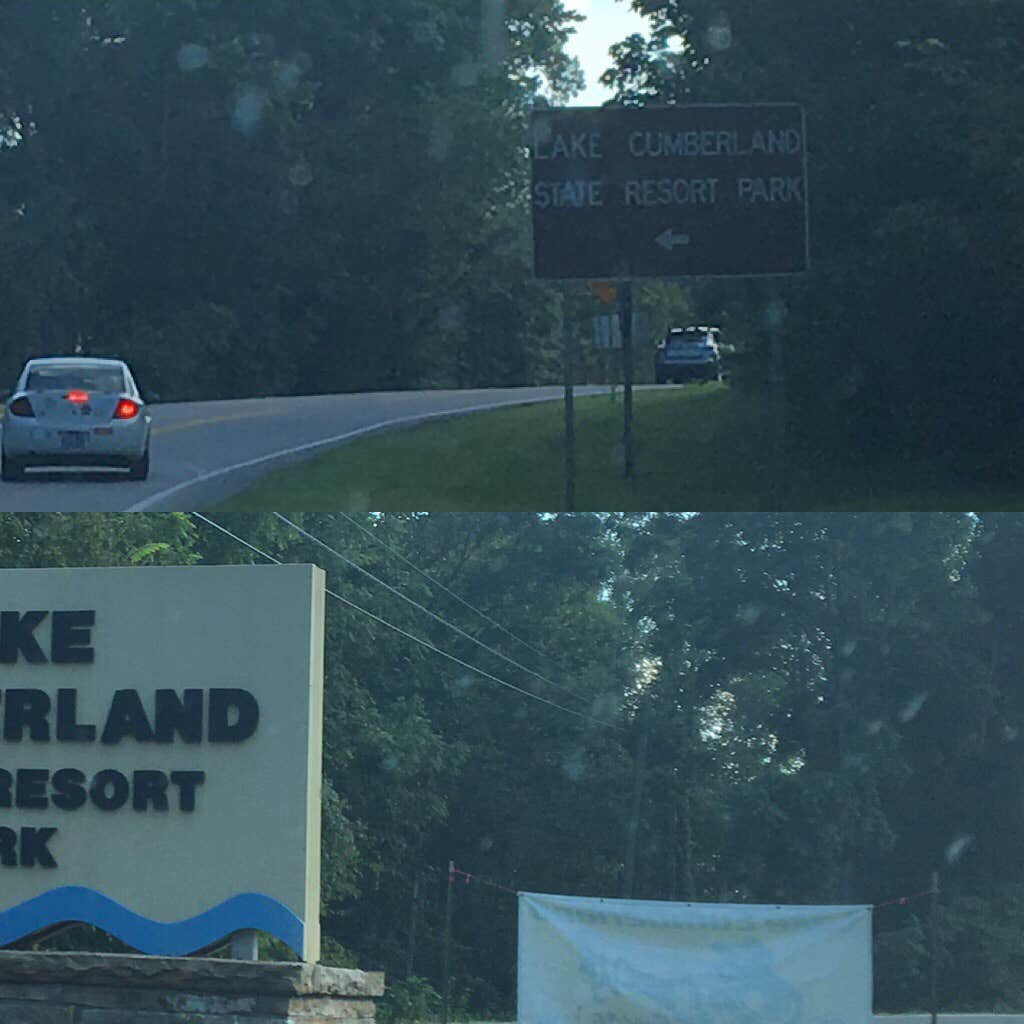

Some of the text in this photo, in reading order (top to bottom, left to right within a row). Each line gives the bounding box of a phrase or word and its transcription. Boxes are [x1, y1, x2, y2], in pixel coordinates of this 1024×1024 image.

[533, 129, 801, 159] LAKE CUMBERLAND
[533, 177, 804, 208] STATE RESORT PARK
